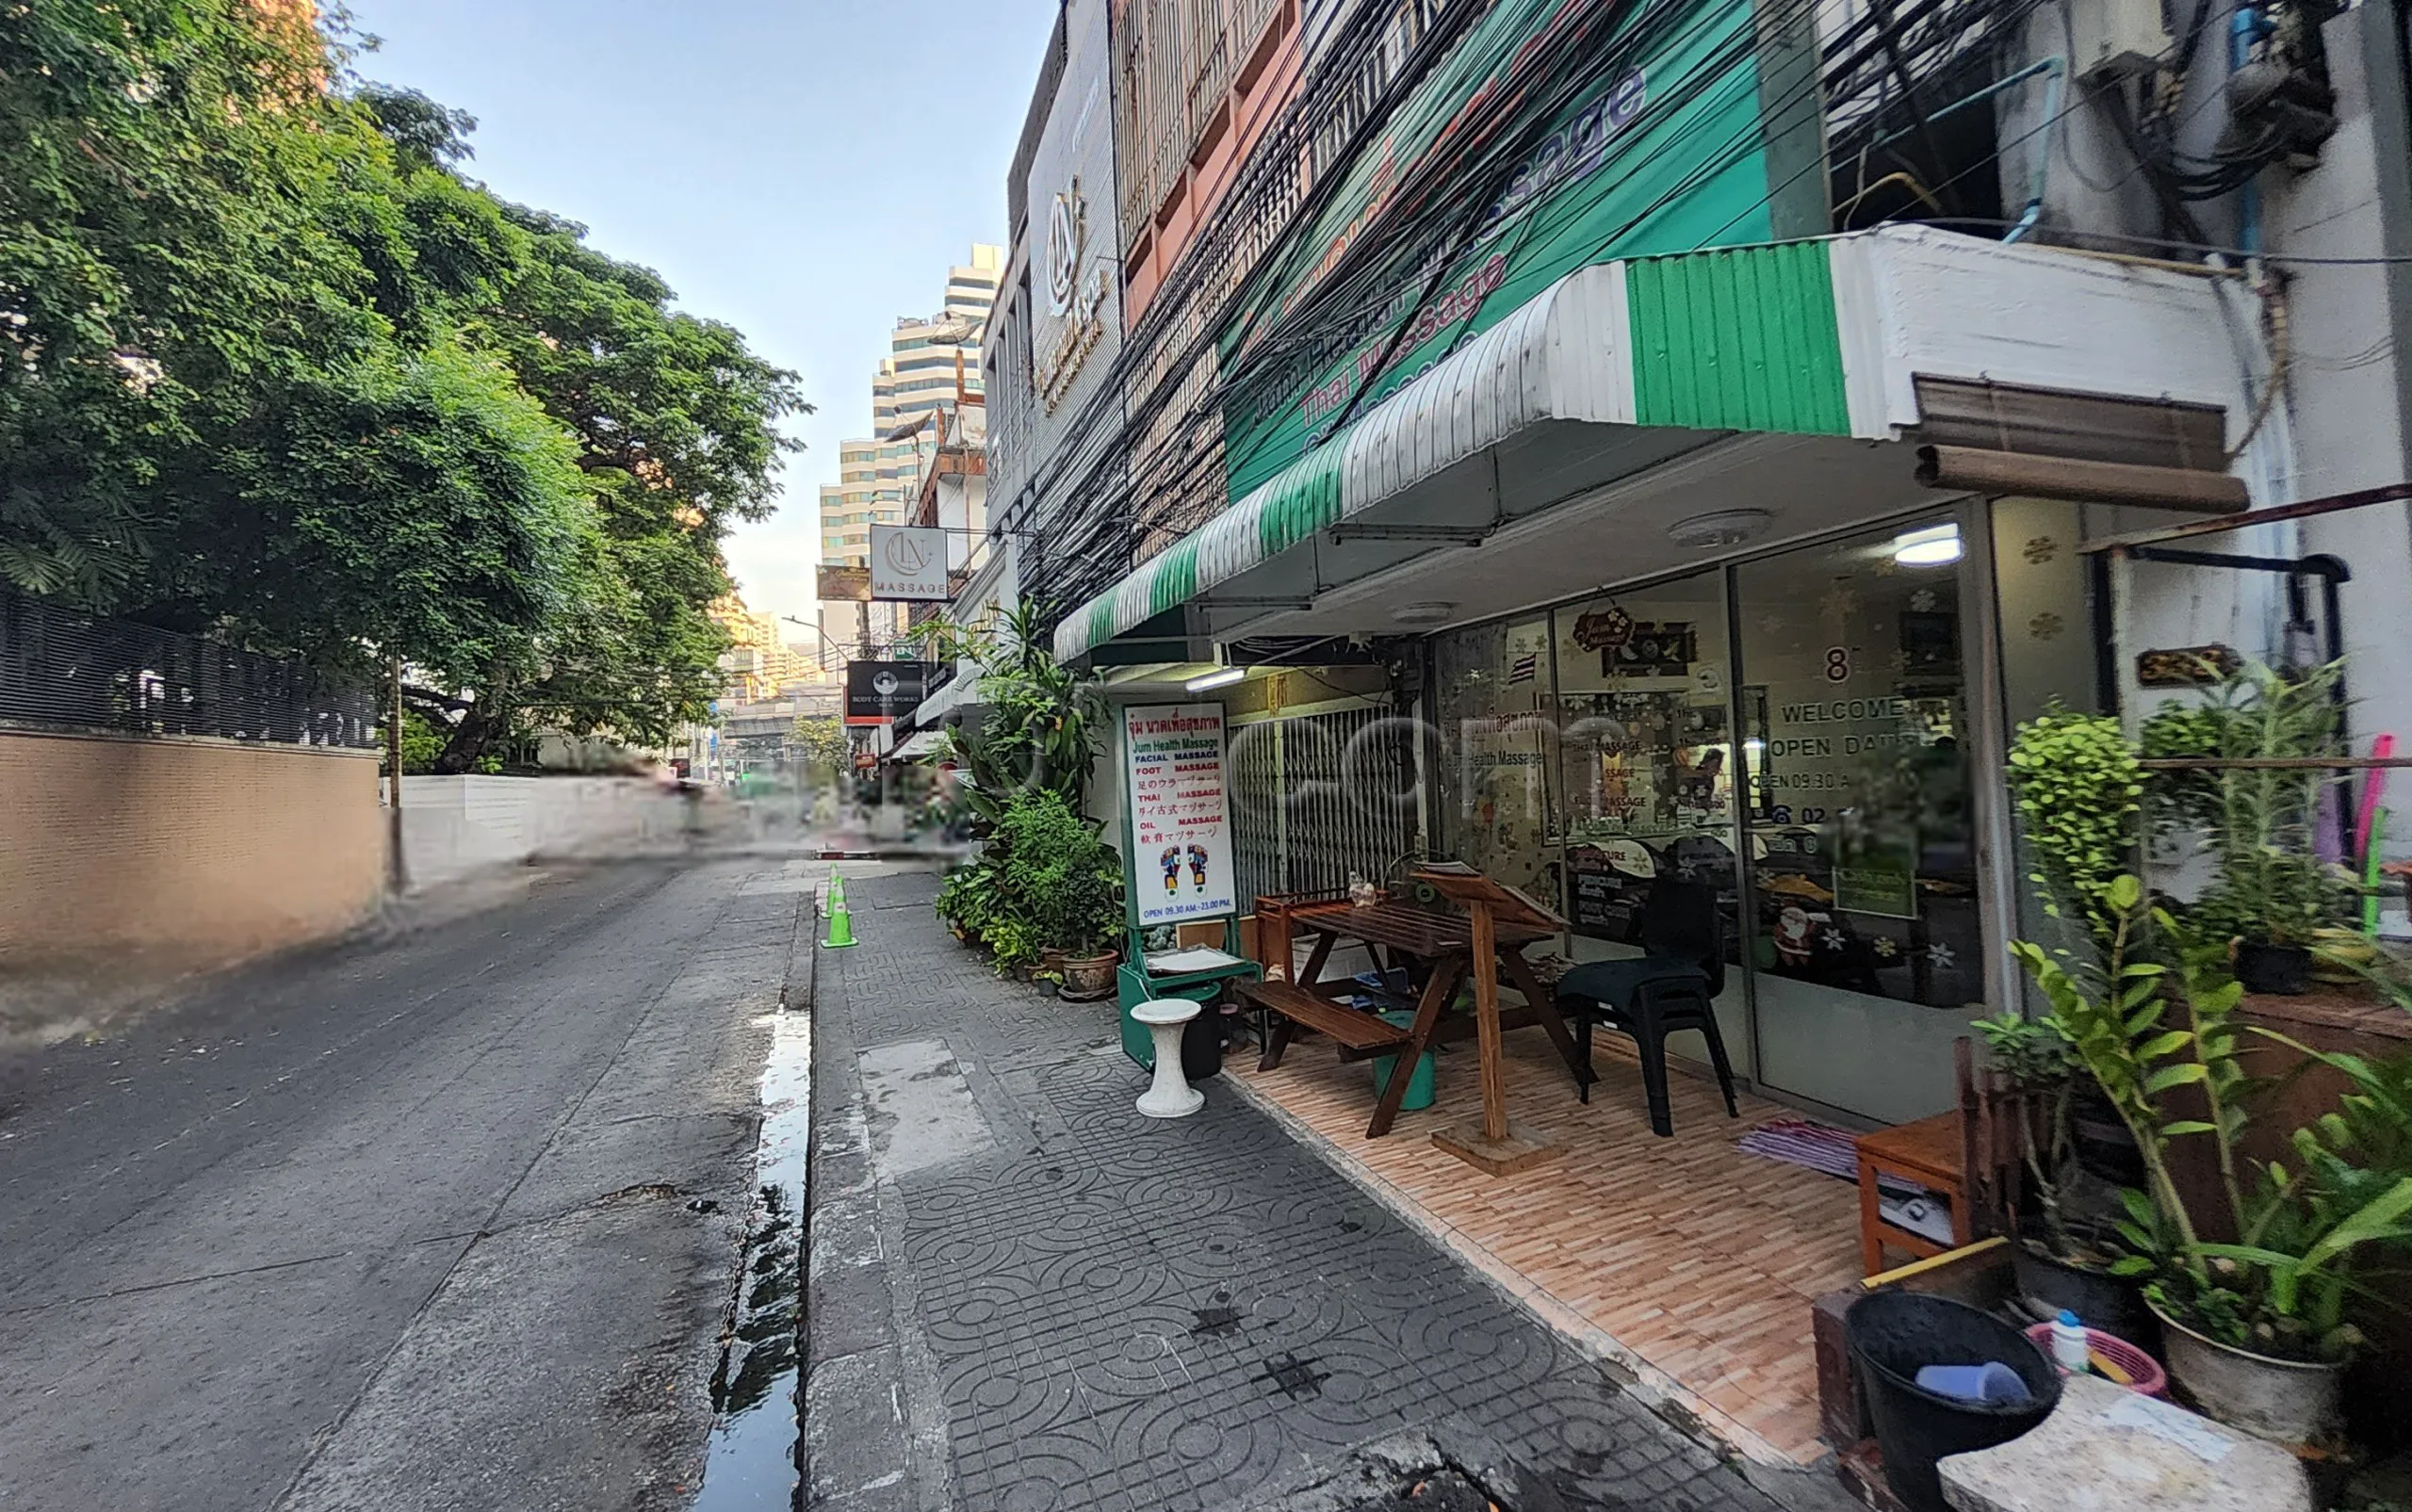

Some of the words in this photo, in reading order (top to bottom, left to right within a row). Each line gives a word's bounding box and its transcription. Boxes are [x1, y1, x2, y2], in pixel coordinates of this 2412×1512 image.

[1300, 364, 1352, 427] Thai
[874, 581, 946, 594] MASSAGE
[1826, 645, 1850, 684] 8
[852, 695, 872, 704] BODY
[1781, 696, 1904, 723] WELCOME
[1153, 740, 1181, 753] Health
[1182, 738, 1218, 751] Massage
[1770, 737, 1832, 758] OPEN
[1134, 754, 1169, 764] FACIAL
[1174, 750, 1219, 761] MASSAGE
[1498, 749, 1543, 770] Massage
[1135, 766, 1162, 775] FOOT
[1174, 761, 1220, 772] MASSAGE
[1137, 793, 1161, 803] THAI
[1176, 789, 1222, 800] MASSAGE
[1139, 821, 1156, 830] OIL
[1177, 815, 1223, 826] MASSAGE
[1143, 908, 1163, 919] OPEN
